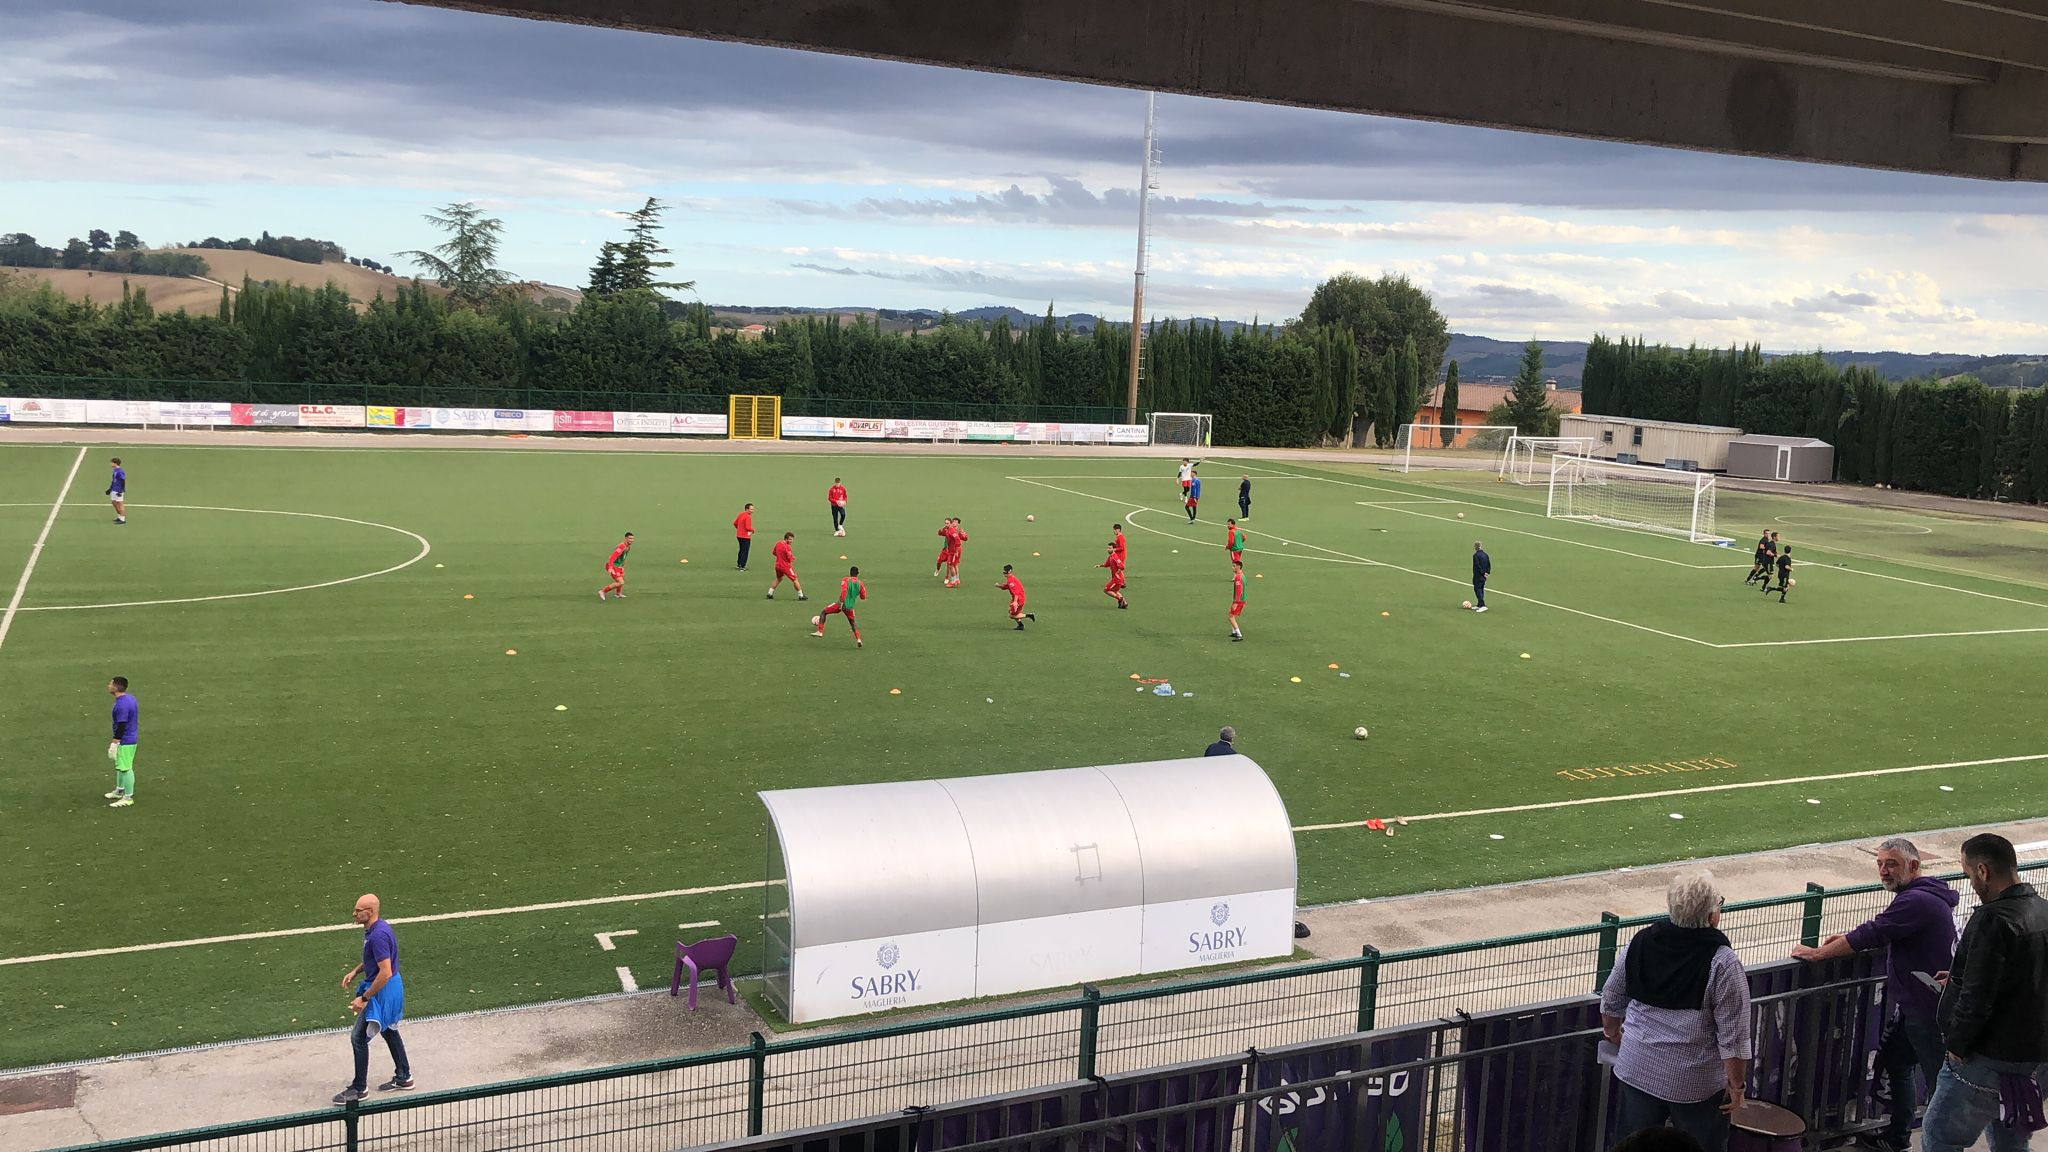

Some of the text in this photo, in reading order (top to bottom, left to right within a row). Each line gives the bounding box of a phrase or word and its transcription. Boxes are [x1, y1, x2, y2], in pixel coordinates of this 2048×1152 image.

[453, 409, 489, 421] SABRY
[1189, 925, 1247, 953] SABRY
[1199, 950, 1235, 962] MAGLIERIA
[851, 969, 920, 999] SABRY
[863, 996, 906, 1009] MAGLIERIA
